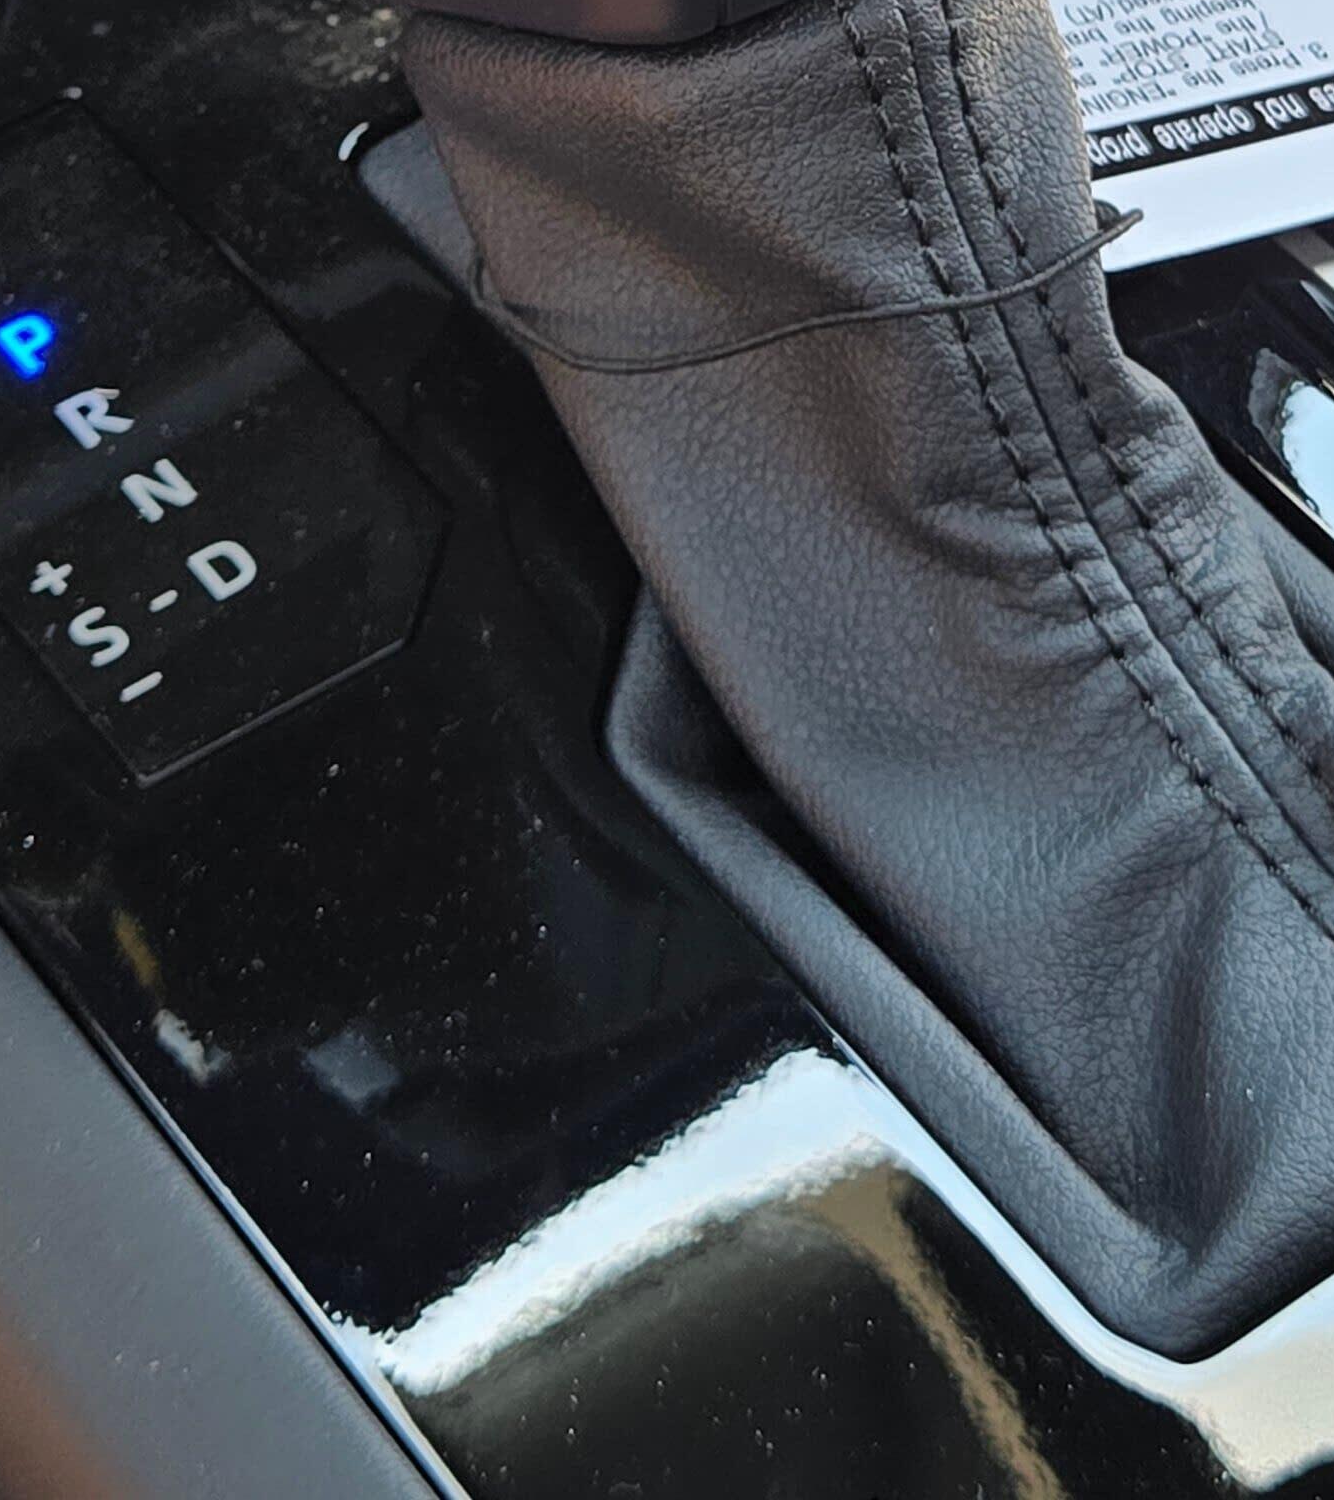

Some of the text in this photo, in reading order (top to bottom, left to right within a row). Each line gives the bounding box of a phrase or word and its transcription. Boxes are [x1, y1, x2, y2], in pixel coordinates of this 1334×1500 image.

[1114, 16, 1155, 34] the
[1182, 68, 1224, 86] the
[1230, 50, 1300, 75] Press
[1154, 106, 1252, 149] operate
[1254, 94, 1305, 128] not
[54, 388, 134, 449] R
[121, 458, 198, 523] N
[187, 539, 258, 601] D
[69, 606, 130, 668] S
